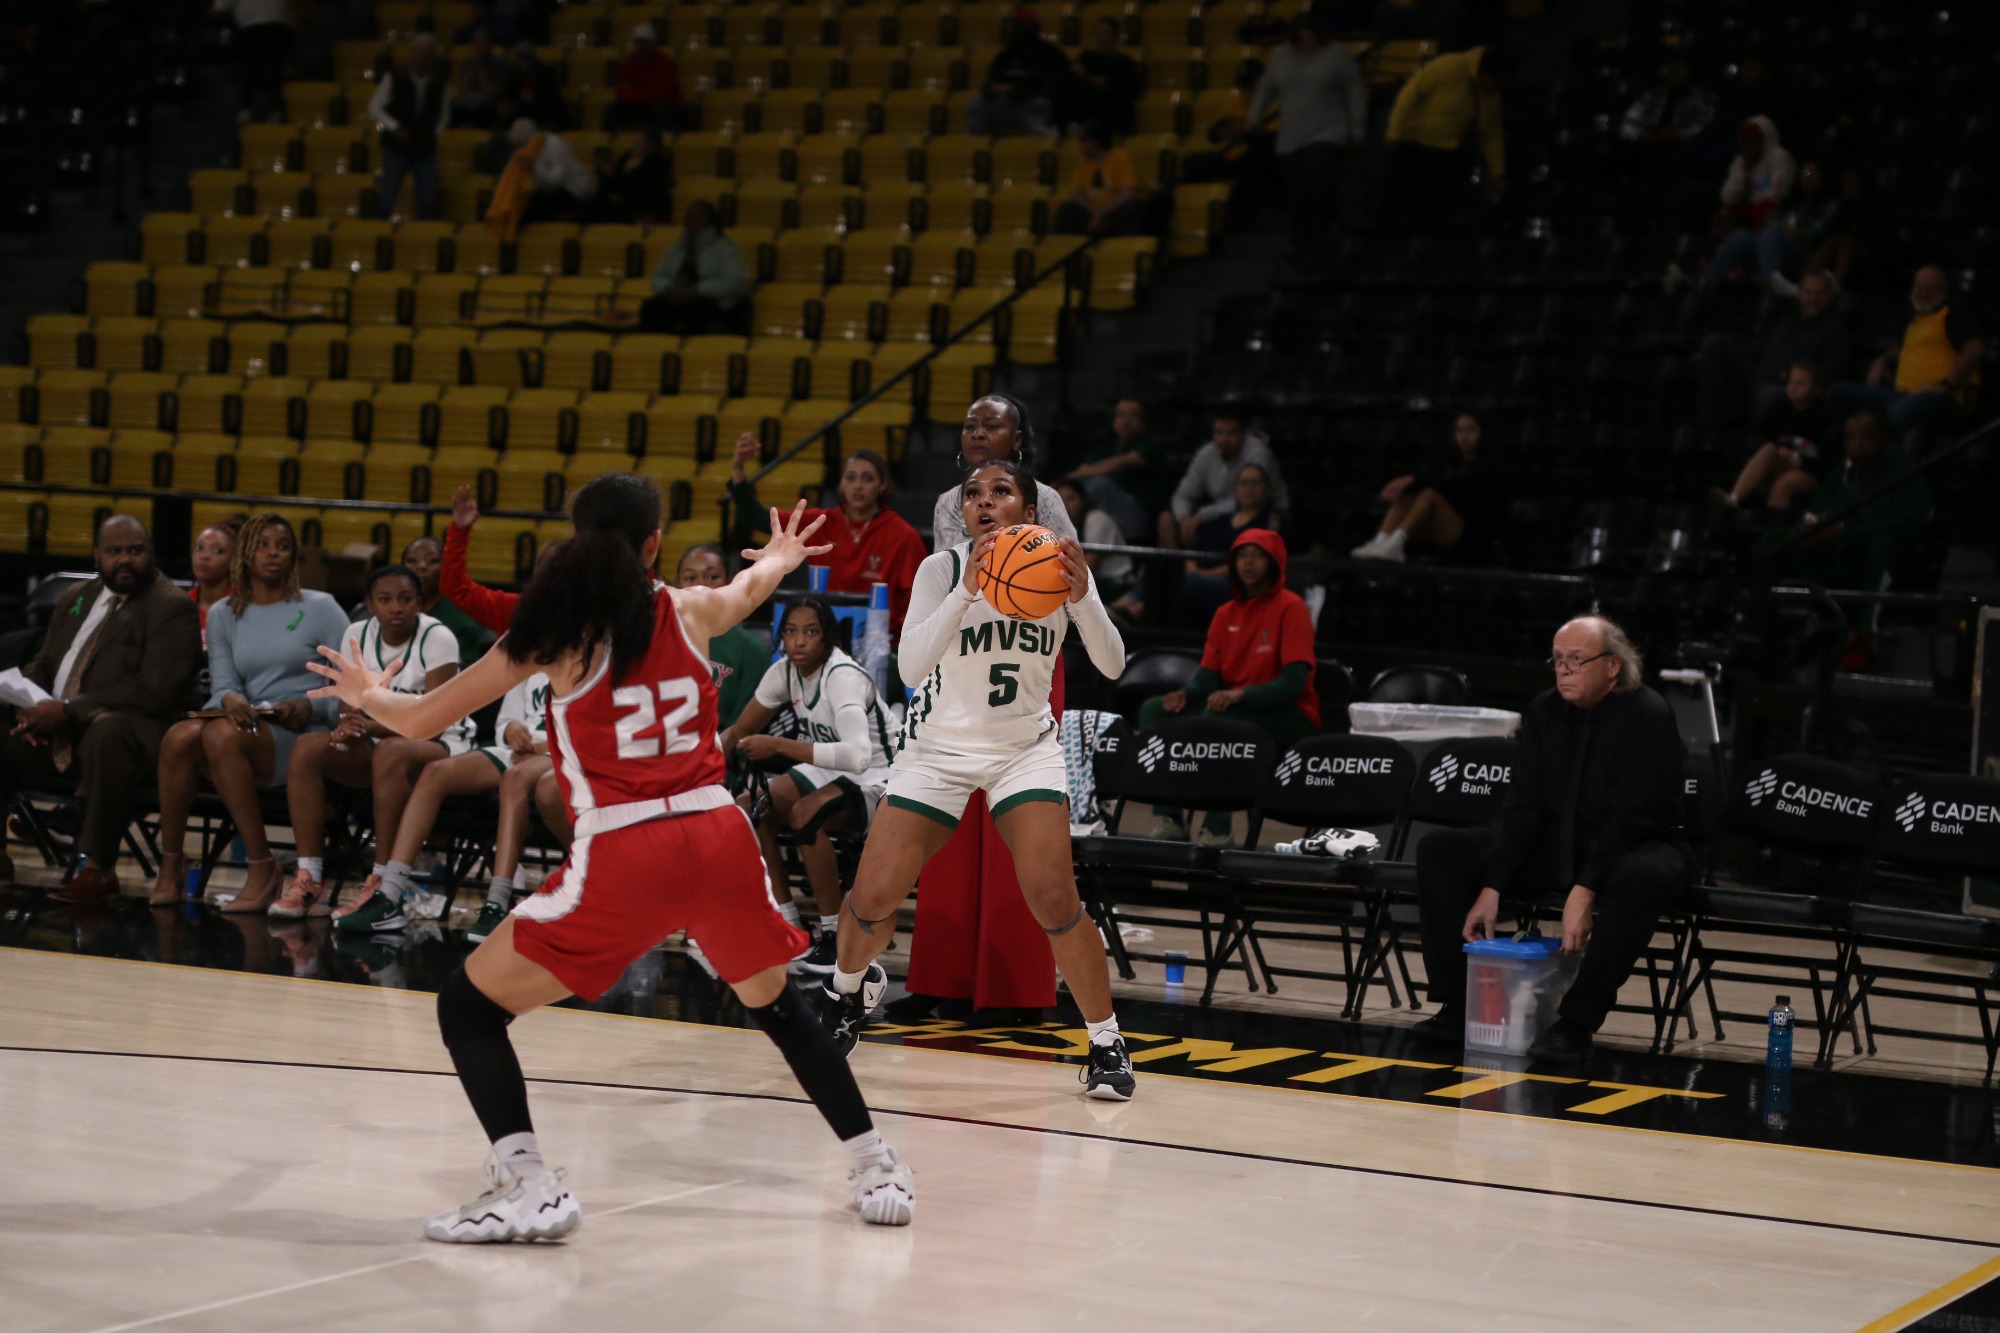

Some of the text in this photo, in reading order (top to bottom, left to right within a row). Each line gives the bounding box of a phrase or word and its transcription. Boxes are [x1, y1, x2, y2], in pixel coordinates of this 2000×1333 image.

[959, 620, 1055, 657] MVSU
[988, 663, 1020, 708] 5
[612, 675, 700, 761] 22
[1170, 742, 1257, 759] CADENCE
[1169, 761, 1199, 772] Bank
[1307, 757, 1394, 774] CADENCE
[1463, 762, 1511, 783] CADE
[1305, 775, 1336, 787] Bank
[1461, 781, 1492, 796] Bank
[1776, 799, 1808, 818] Bank
[1781, 781, 1873, 818] CADENCE
[1932, 801, 2000, 824] CADEN
[1930, 821, 1964, 836] Bank
